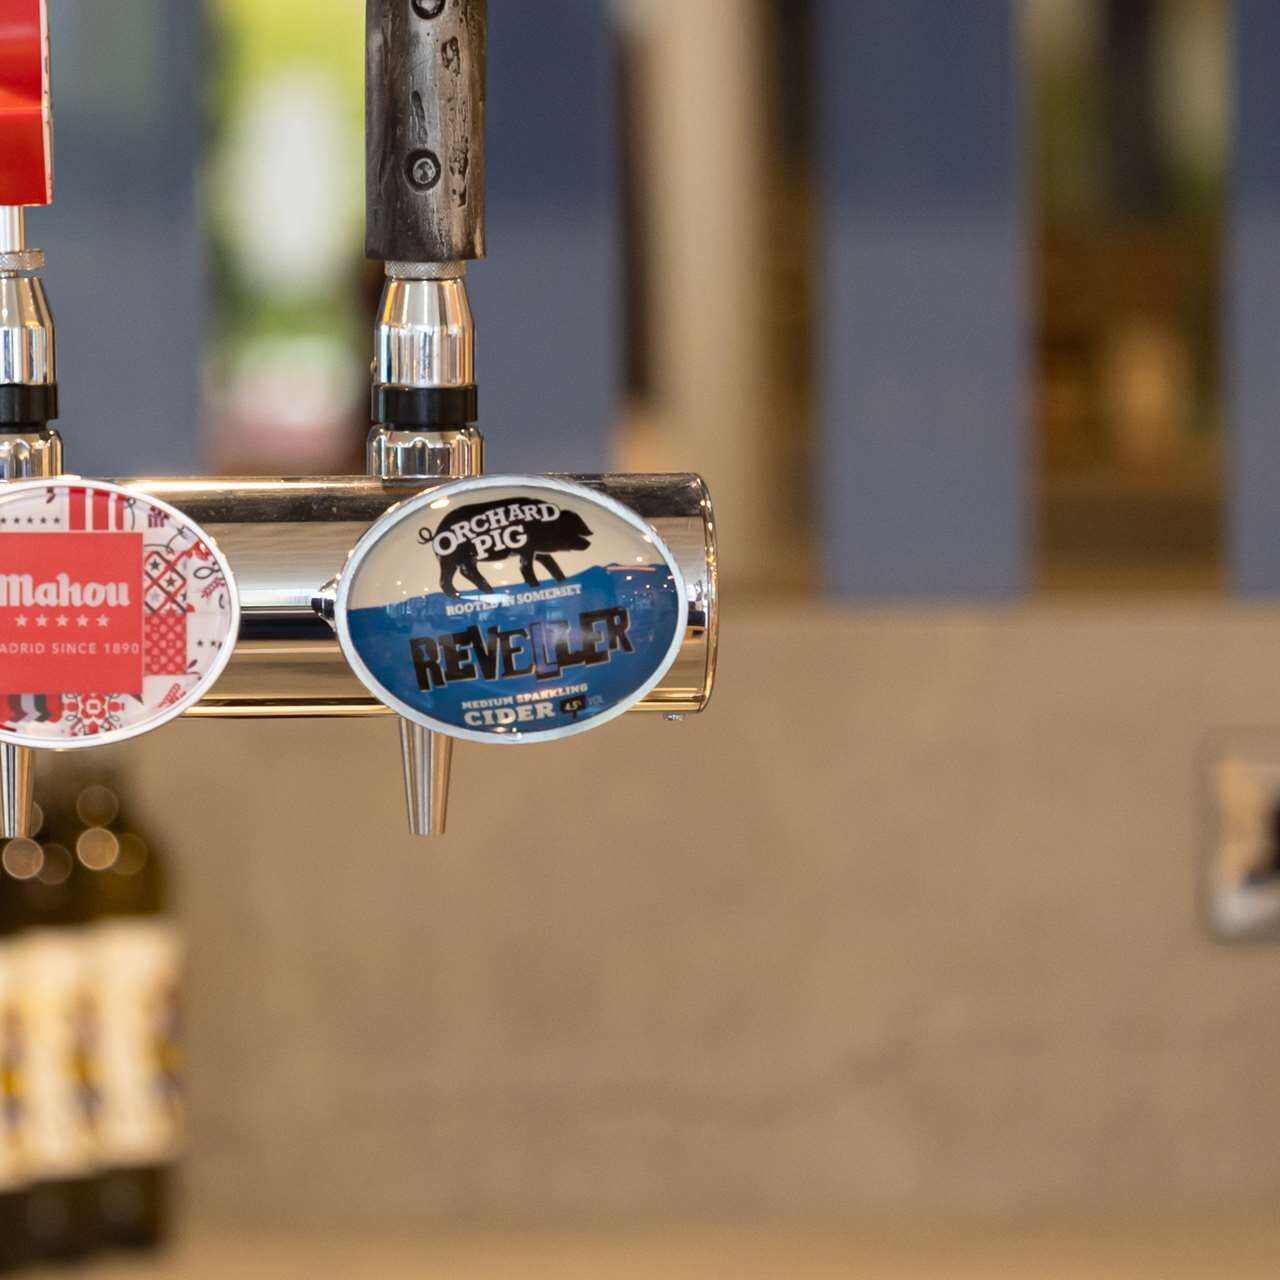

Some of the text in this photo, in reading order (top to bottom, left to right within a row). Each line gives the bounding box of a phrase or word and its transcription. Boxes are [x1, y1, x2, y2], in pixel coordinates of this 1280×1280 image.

[432, 501, 561, 558] ORCHARD
[471, 524, 528, 561] PIG
[516, 583, 582, 605] SOMERSET
[51, 643, 97, 656] SINCE
[104, 643, 140, 656] 1890
[409, 607, 635, 692] REVELLER
[462, 682, 589, 710] MEDIUM SPARKLING
[463, 701, 555, 726] CIDER
